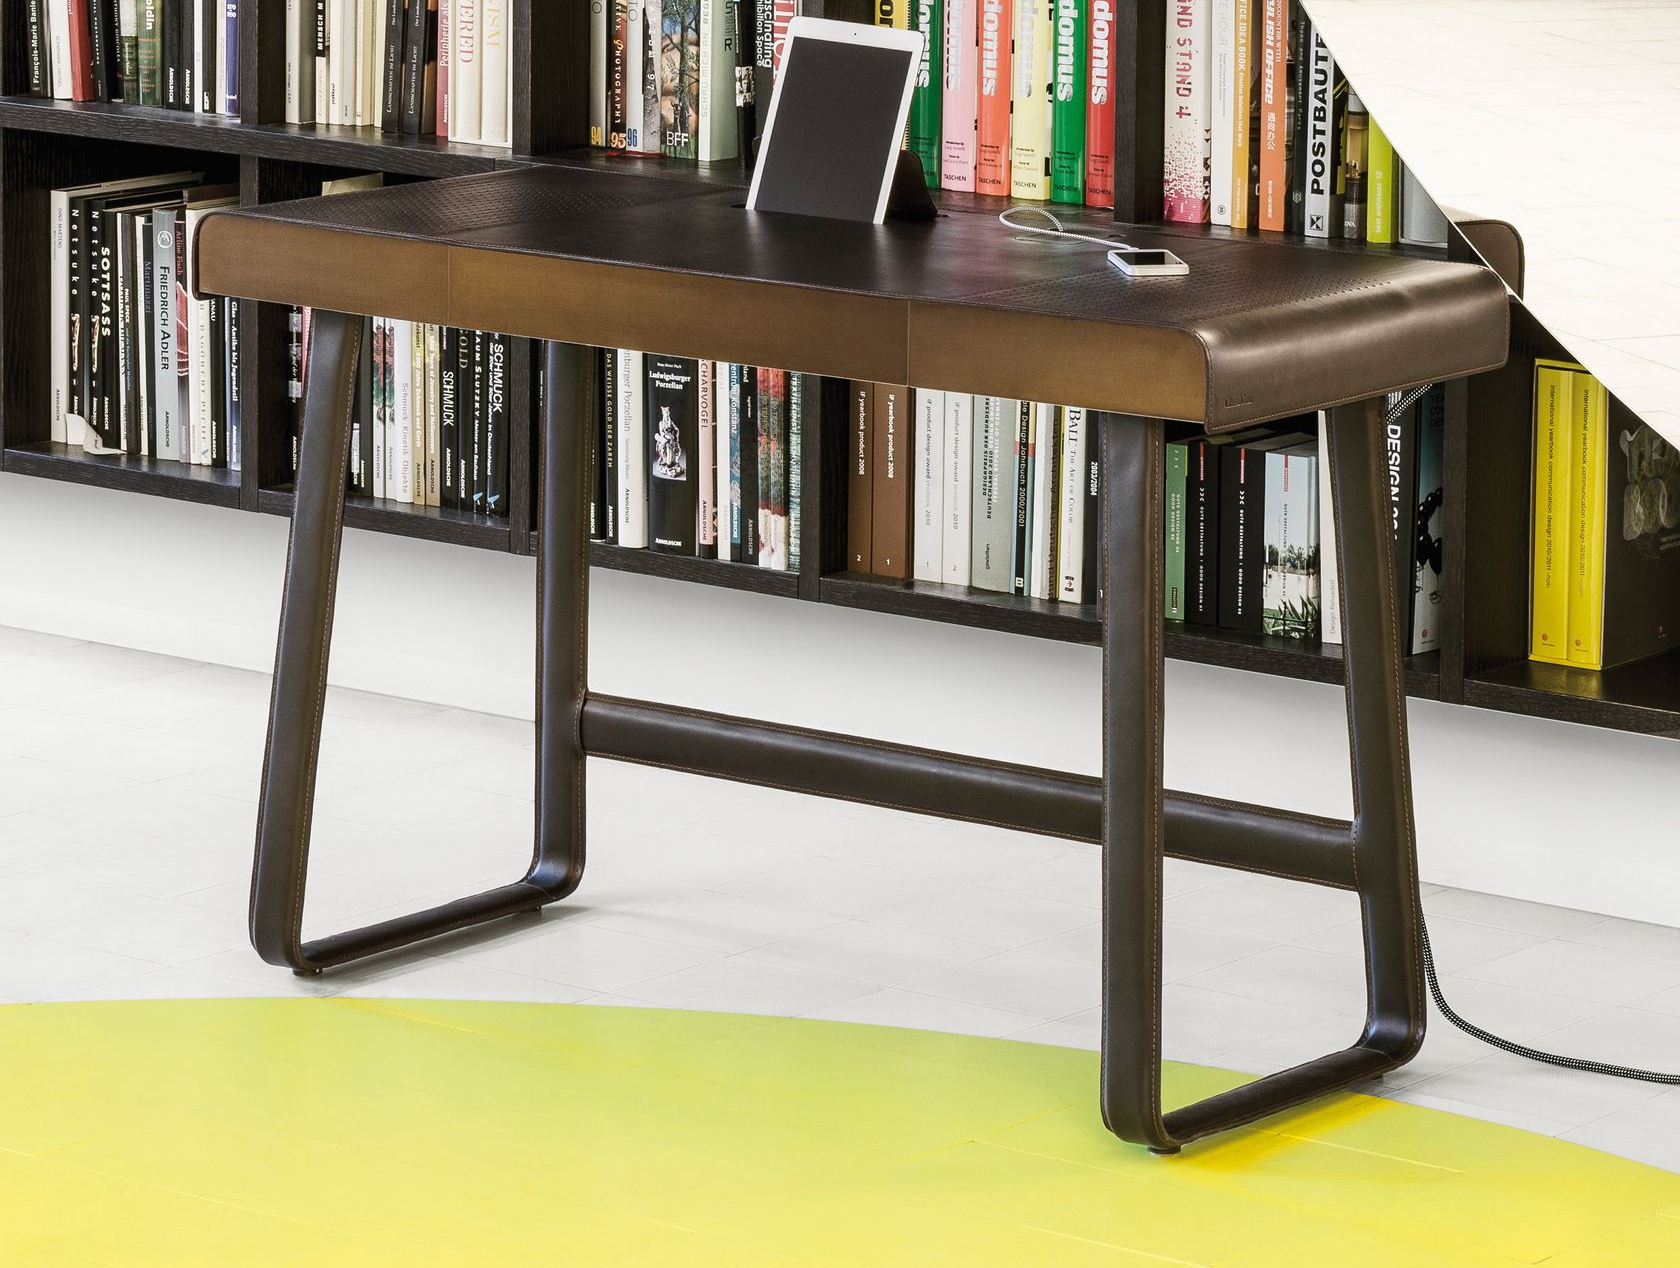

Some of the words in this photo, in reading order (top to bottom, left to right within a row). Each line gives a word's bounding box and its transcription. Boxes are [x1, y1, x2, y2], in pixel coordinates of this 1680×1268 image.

[1238, 22, 1247, 45] IDEA
[31, 24, 41, 83] François-Marie
[1091, 0, 1113, 105] domus
[1175, 36, 1194, 98] STAND
[1238, 46, 1247, 71] BOOK
[1175, 105, 1192, 119] 4
[591, 125, 602, 145] 94
[610, 131, 627, 149] 95
[627, 127, 638, 148] 96
[666, 131, 689, 147] BFF
[943, 173, 967, 182] TASCHEN
[71, 209, 80, 295] Netsuke
[101, 246, 111, 336] SOTTSASS
[159, 266, 170, 327] FRIEDRICH
[160, 329, 171, 371] ADLER
[493, 343, 504, 413] SCHMUCK
[649, 370, 692, 383] Ludwigsburger
[655, 380, 684, 390] Porzellan
[442, 370, 454, 427] SCHMUCK
[857, 398, 867, 430] yearbook
[1548, 384, 1556, 427] international
[731, 396, 739, 434] Konstanz
[1020, 415, 1028, 443] Design
[857, 431, 866, 458] product
[1546, 428, 1554, 460] yearbook
[401, 460, 409, 494] Objekte
[858, 458, 866, 475] 2008
[1019, 445, 1028, 484] Jahrbuch
[1090, 461, 1098, 496] 2003/2004
[1546, 461, 1554, 512] communication
[1018, 487, 1026, 528] 2000/2001
[1545, 514, 1553, 538] design
[1545, 540, 1553, 572] 2010/2011
